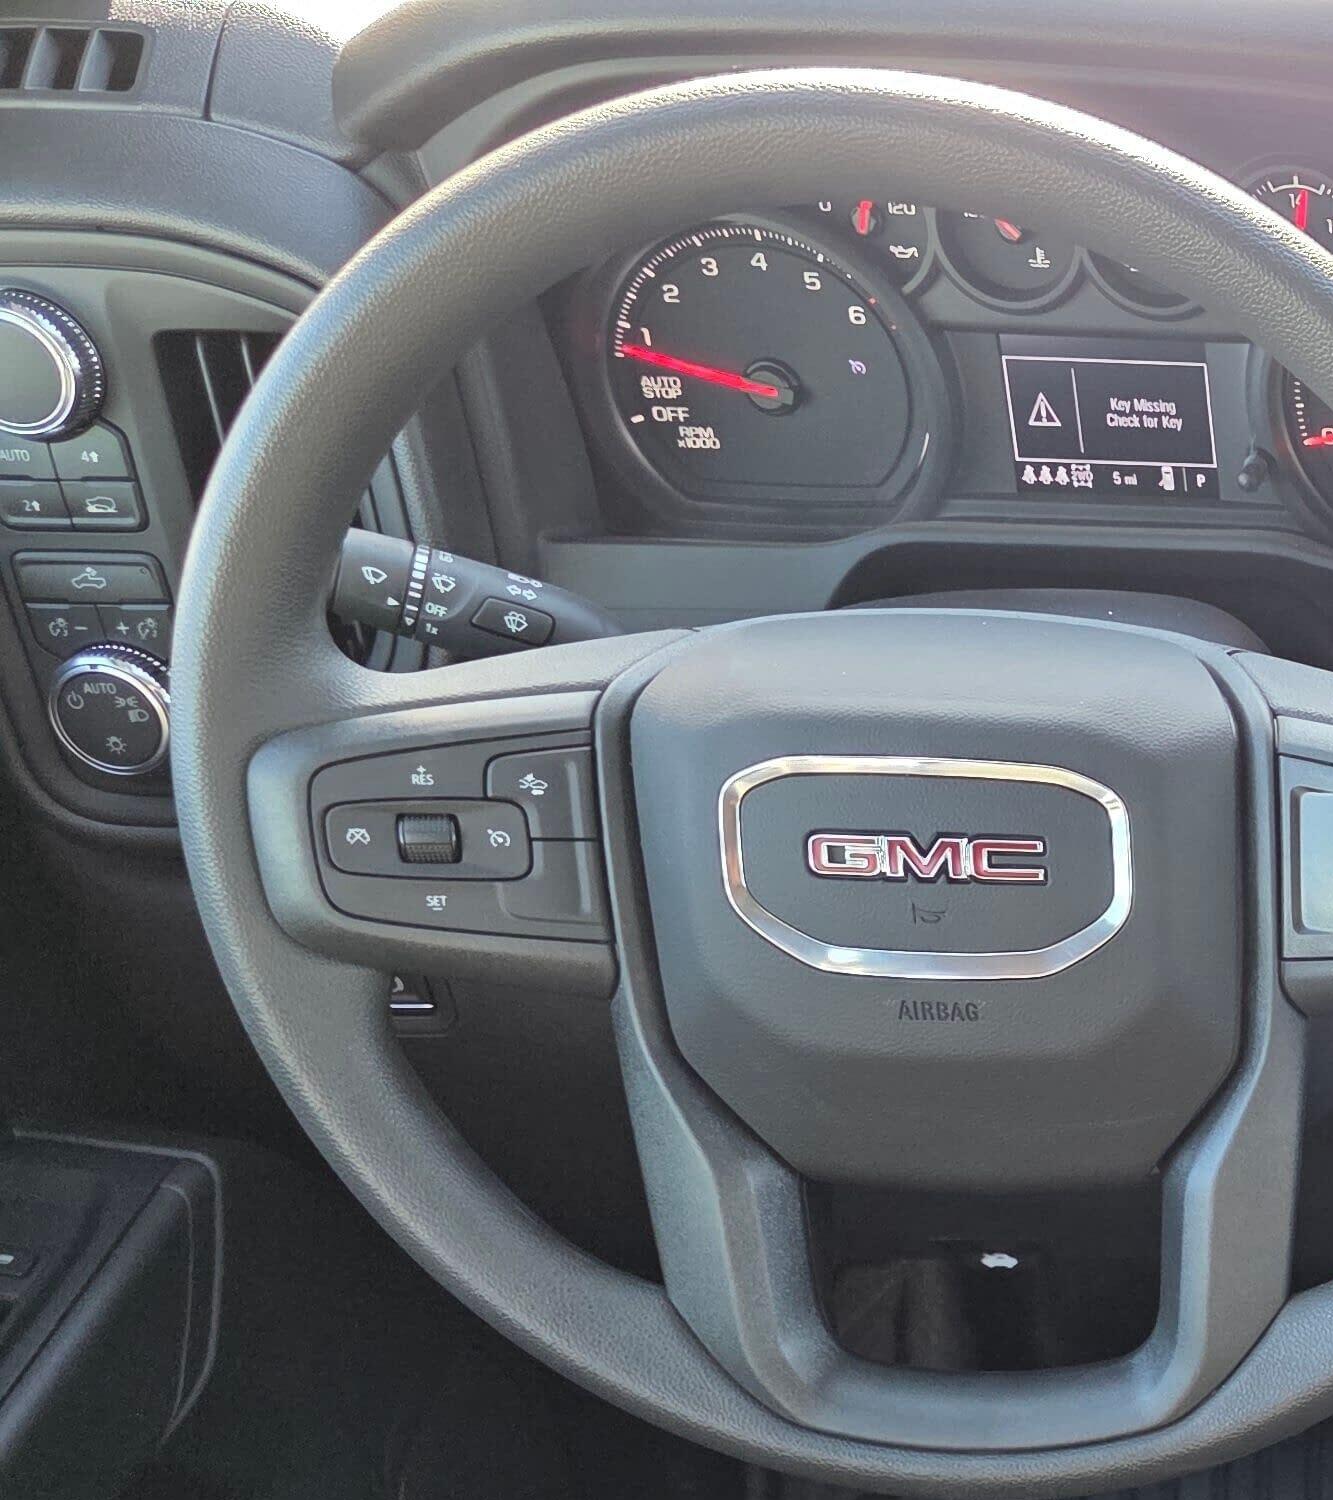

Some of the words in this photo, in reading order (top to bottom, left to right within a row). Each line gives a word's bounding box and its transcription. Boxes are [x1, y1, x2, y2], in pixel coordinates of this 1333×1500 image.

[702, 258, 719, 276] 3
[750, 252, 768, 272] 4
[804, 272, 821, 291] 5
[662, 284, 680, 304] 2
[848, 306, 866, 325] 6
[640, 327, 652, 347] 1
[641, 375, 682, 388] AUTO
[642, 387, 682, 399] STOP
[652, 406, 690, 422] OFF
[1110, 397, 1131, 413] Key
[1134, 398, 1176, 416] Missing
[1106, 413, 1140, 428] Check
[1143, 414, 1158, 428] for
[1162, 416, 1183, 431] Key
[679, 426, 714, 439] RPM
[0, 449, 31, 462] AUTO
[1112, 471, 1122, 485] 5
[1196, 474, 1206, 487] P
[425, 602, 448, 617] OFF
[83, 682, 117, 694] AUTO
[411, 774, 434, 786] RES
[808, 833, 1046, 881] GMC
[425, 895, 448, 907] SET
[898, 1000, 979, 1022] AIRBAG
